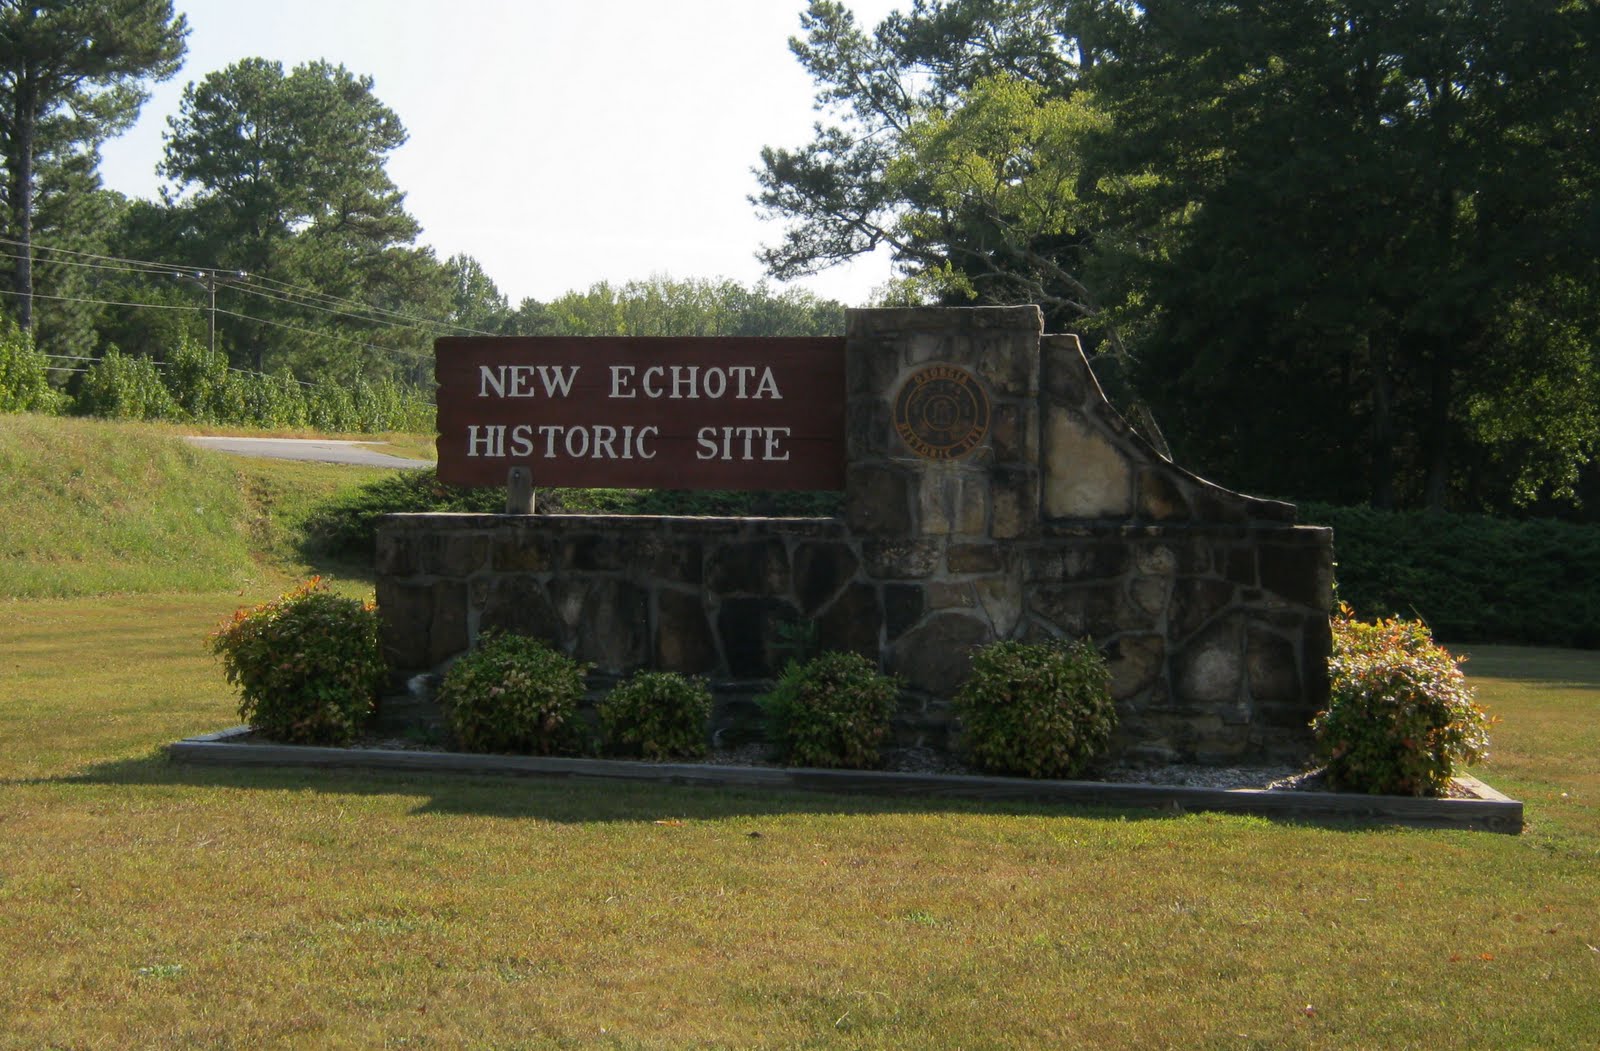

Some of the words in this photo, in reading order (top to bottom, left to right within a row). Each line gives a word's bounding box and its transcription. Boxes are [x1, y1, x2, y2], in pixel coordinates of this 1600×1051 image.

[478, 365, 581, 398] NEW
[608, 366, 783, 399] ECHOTA
[467, 425, 659, 459] HISTORIC
[696, 427, 791, 461] SITE
